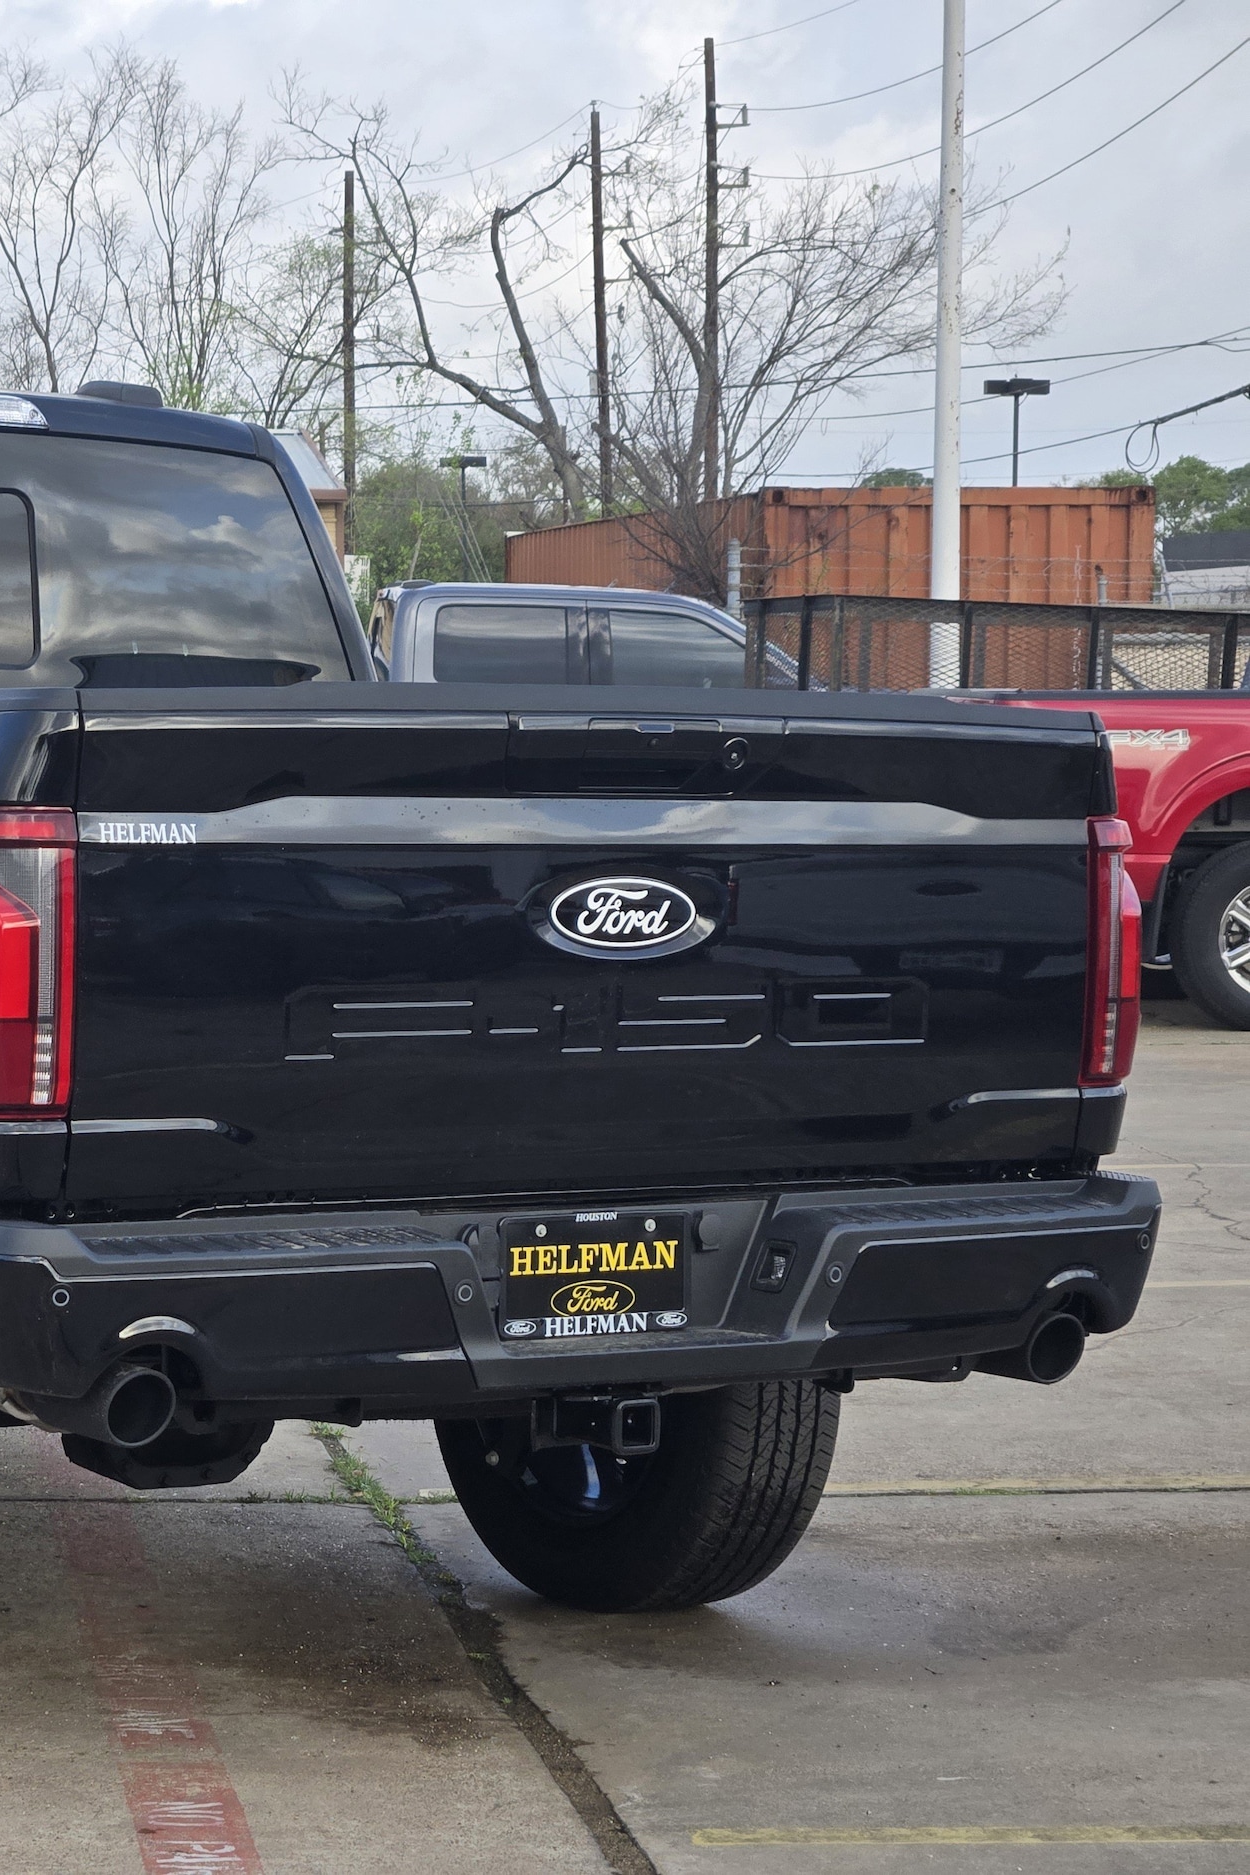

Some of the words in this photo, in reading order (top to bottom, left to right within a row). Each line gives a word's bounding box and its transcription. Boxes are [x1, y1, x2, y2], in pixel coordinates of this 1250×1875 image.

[1104, 728, 1191, 750] FX4
[98, 822, 197, 844] HELFMAN
[576, 887, 672, 935] Ford
[575, 1211, 618, 1223] HOUSTON
[509, 1240, 679, 1277] HELFMAN
[566, 1284, 620, 1313] Ford
[544, 1312, 649, 1338] HELFMAN
[141, 1801, 225, 1827] NO
